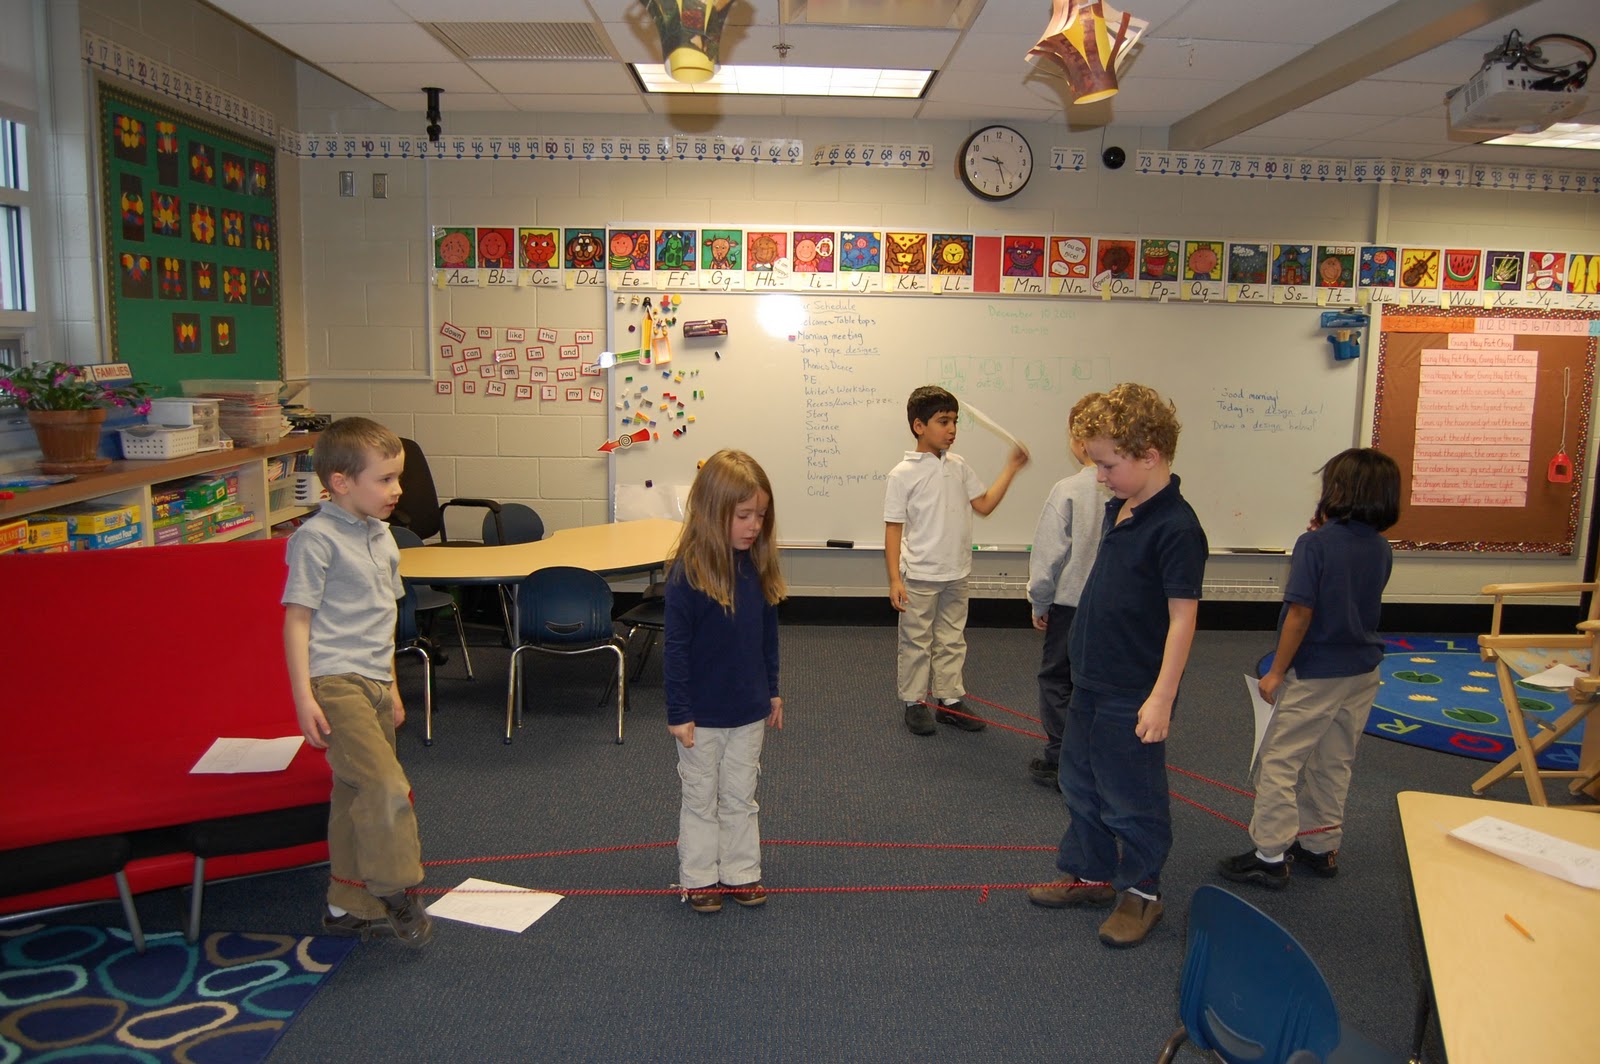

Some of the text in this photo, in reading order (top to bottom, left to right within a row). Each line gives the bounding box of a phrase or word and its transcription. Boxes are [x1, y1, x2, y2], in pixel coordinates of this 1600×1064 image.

[114, 53, 147, 77] 18 20
[308, 141, 799, 157] 37 38 39 40 41 42 43 44 45 46 47 48 49 50 51 52 53 54 55 56 57 58 59 60 61 62 63
[829, 148, 930, 161] 65 66 67 68 69 70
[1054, 153, 1083, 164] 71 72
[1140, 157, 1366, 176] 73 74 75 76 77 78 79 80 81 82 83 84 85
[1064, 242, 1074, 250] You
[1064, 251, 1078, 260] nice!
[814, 298, 856, 311] Schedule
[858, 315, 876, 326] tops
[444, 327, 461, 339] down
[798, 329, 863, 345] Morning meeting
[825, 348, 841, 357] rope
[95, 366, 130, 377] FAMILIES
[1216, 400, 1243, 418] Today
[1246, 405, 1254, 413] is
[806, 410, 828, 422] Story
[806, 421, 840, 430] Science
[1213, 421, 1235, 430] Draw
[807, 434, 837, 443] Finish
[806, 445, 840, 457] Spanish
[807, 457, 828, 468] Rest
[807, 471, 868, 486] Wrapping paper
